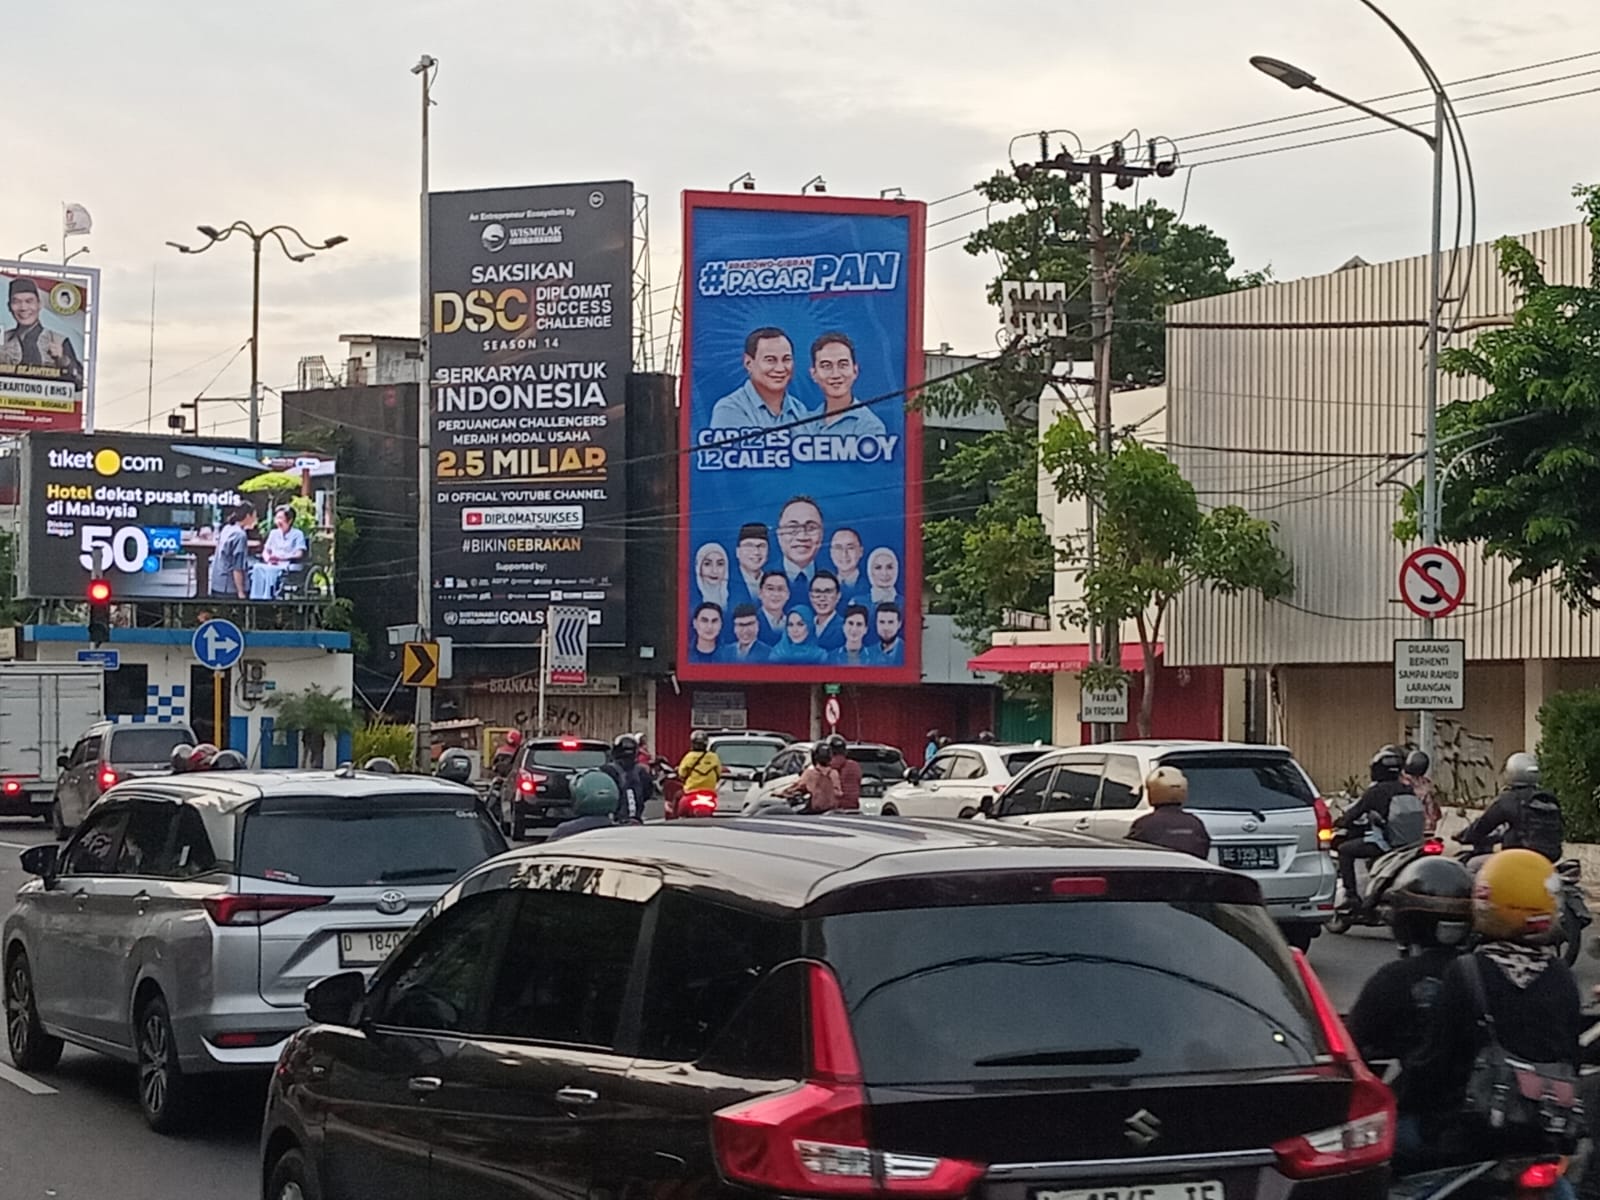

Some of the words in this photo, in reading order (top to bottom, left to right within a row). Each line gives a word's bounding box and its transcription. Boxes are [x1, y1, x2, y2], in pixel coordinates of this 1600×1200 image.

[509, 225, 562, 237] WISMILAK
[471, 261, 574, 283] SAKSIKAN
[536, 284, 612, 301] DIPLOMAT
[433, 288, 527, 333] DSC
[536, 300, 612, 316] SUCCESS
[536, 316, 612, 330] CHALLENGE
[483, 338, 537, 351] SEASON
[544, 338, 560, 348] 14
[438, 365, 537, 384] BERKARYA
[540, 362, 607, 381] UNTUK
[437, 382, 607, 412] INDONESIA
[438, 417, 516, 431] PERJUANGAN
[519, 415, 607, 428] CHALLENGERS
[453, 433, 499, 446] MERAIH
[501, 432, 545, 444] MODAL
[548, 431, 590, 442] USAHA
[791, 435, 899, 463] GEMOY
[437, 450, 485, 477] 2.5
[492, 447, 607, 475] MILIAR
[47, 484, 92, 500] Hotel
[95, 486, 142, 502] dekat
[145, 490, 191, 505] pusat
[193, 491, 241, 506] medis
[437, 493, 449, 503] DI
[451, 491, 499, 503] OFFICIAL
[501, 490, 551, 502] YOUTUBE
[553, 489, 607, 501] CHANNEL
[46, 500, 63, 515] di
[66, 501, 137, 520] Malaysia
[485, 511, 579, 525] DIPLOMATSUKSES
[462, 538, 582, 553] #BIKINGEBRAKAN
[495, 563, 535, 573] Supported
[500, 610, 544, 625] GOALS
[1408, 645, 1450, 654] DILARANG
[1409, 657, 1449, 666] BERHENTI
[1399, 670, 1428, 679] SAMPAI
[1430, 670, 1459, 679] RAMBU
[1406, 683, 1451, 692] LARANGAN
[1403, 696, 1454, 705] BERIKUTNYA
